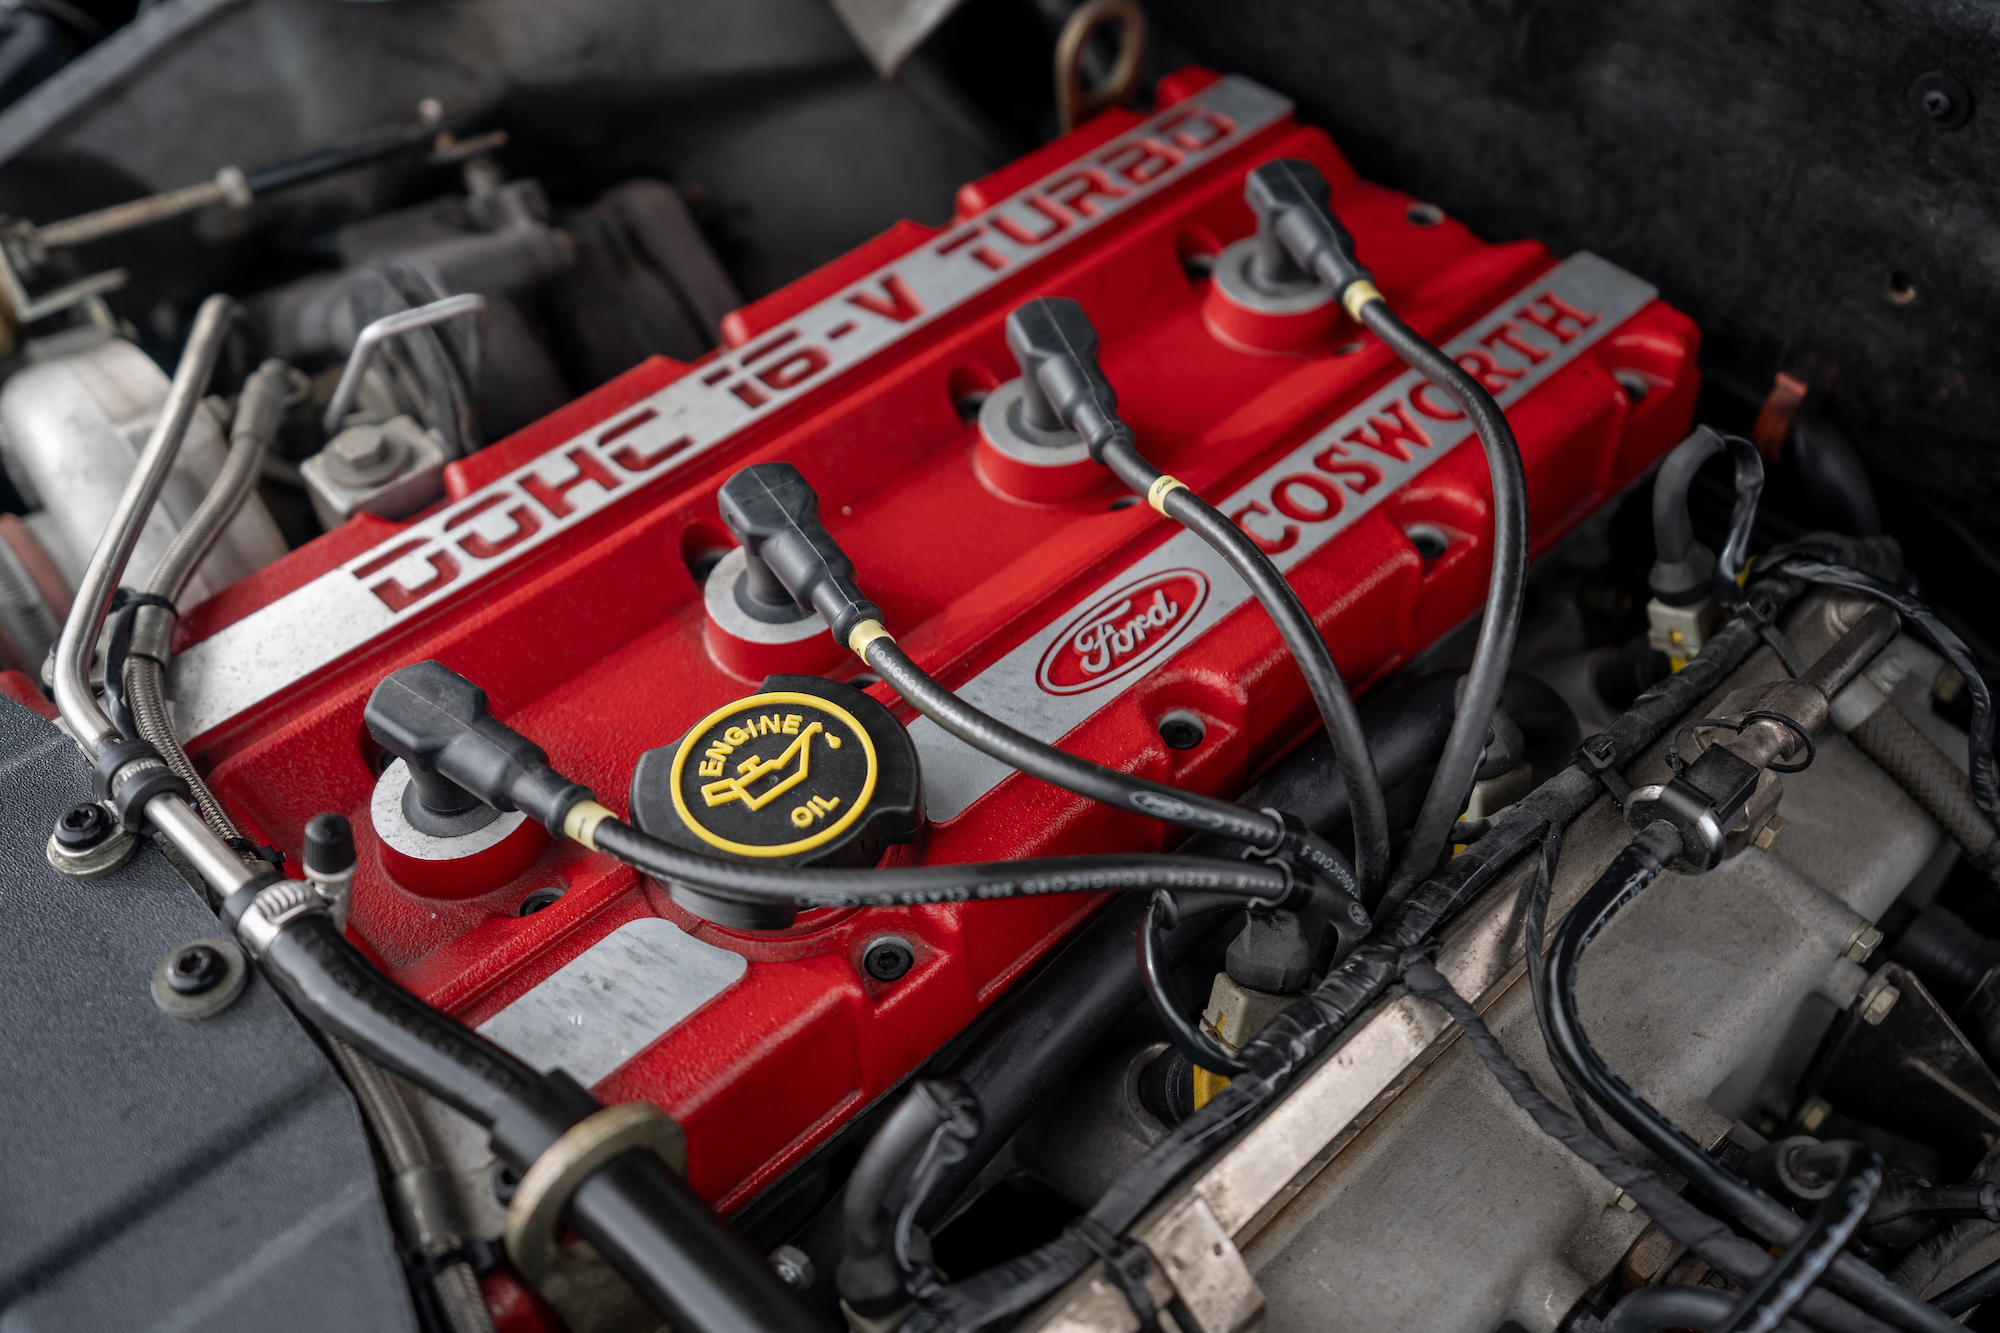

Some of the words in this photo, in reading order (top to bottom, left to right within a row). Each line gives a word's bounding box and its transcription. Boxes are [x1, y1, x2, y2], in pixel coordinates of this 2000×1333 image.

[352, 406, 697, 614] DOHC
[702, 272, 929, 409] 16-V
[934, 104, 1239, 272] TURBO
[1073, 588, 1178, 674] Ford
[1229, 288, 1604, 555] COSWORTH
[867, 641, 922, 697] BOUGICOR
[698, 713, 803, 777] ENGINE
[790, 795, 840, 828] OIL
[1229, 818, 1279, 842] LASS
[902, 885, 970, 906] CLASS
